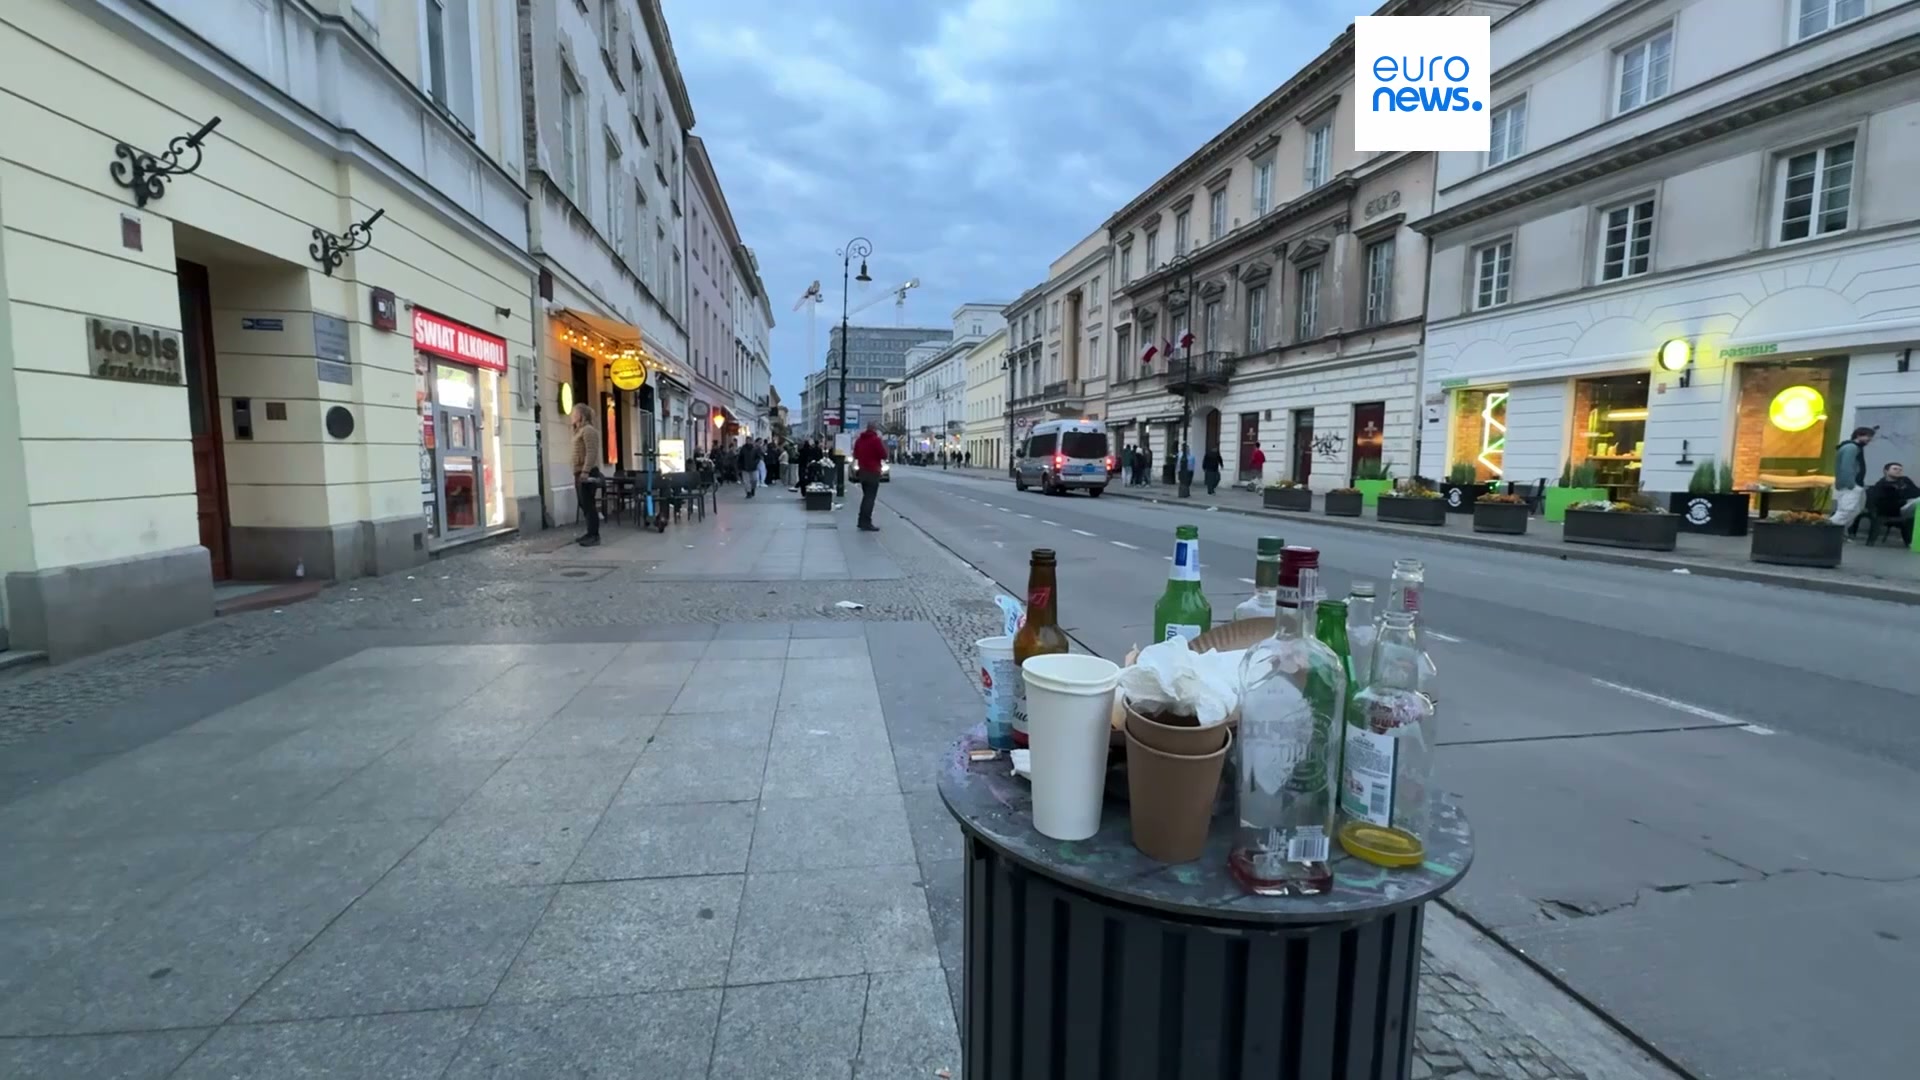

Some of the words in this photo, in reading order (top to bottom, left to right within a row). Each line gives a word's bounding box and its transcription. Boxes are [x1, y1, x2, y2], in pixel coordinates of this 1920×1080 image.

[93, 318, 178, 361] kobis
[415, 312, 455, 352] ŚWIAT
[457, 331, 505, 367] ALKOHOLI
